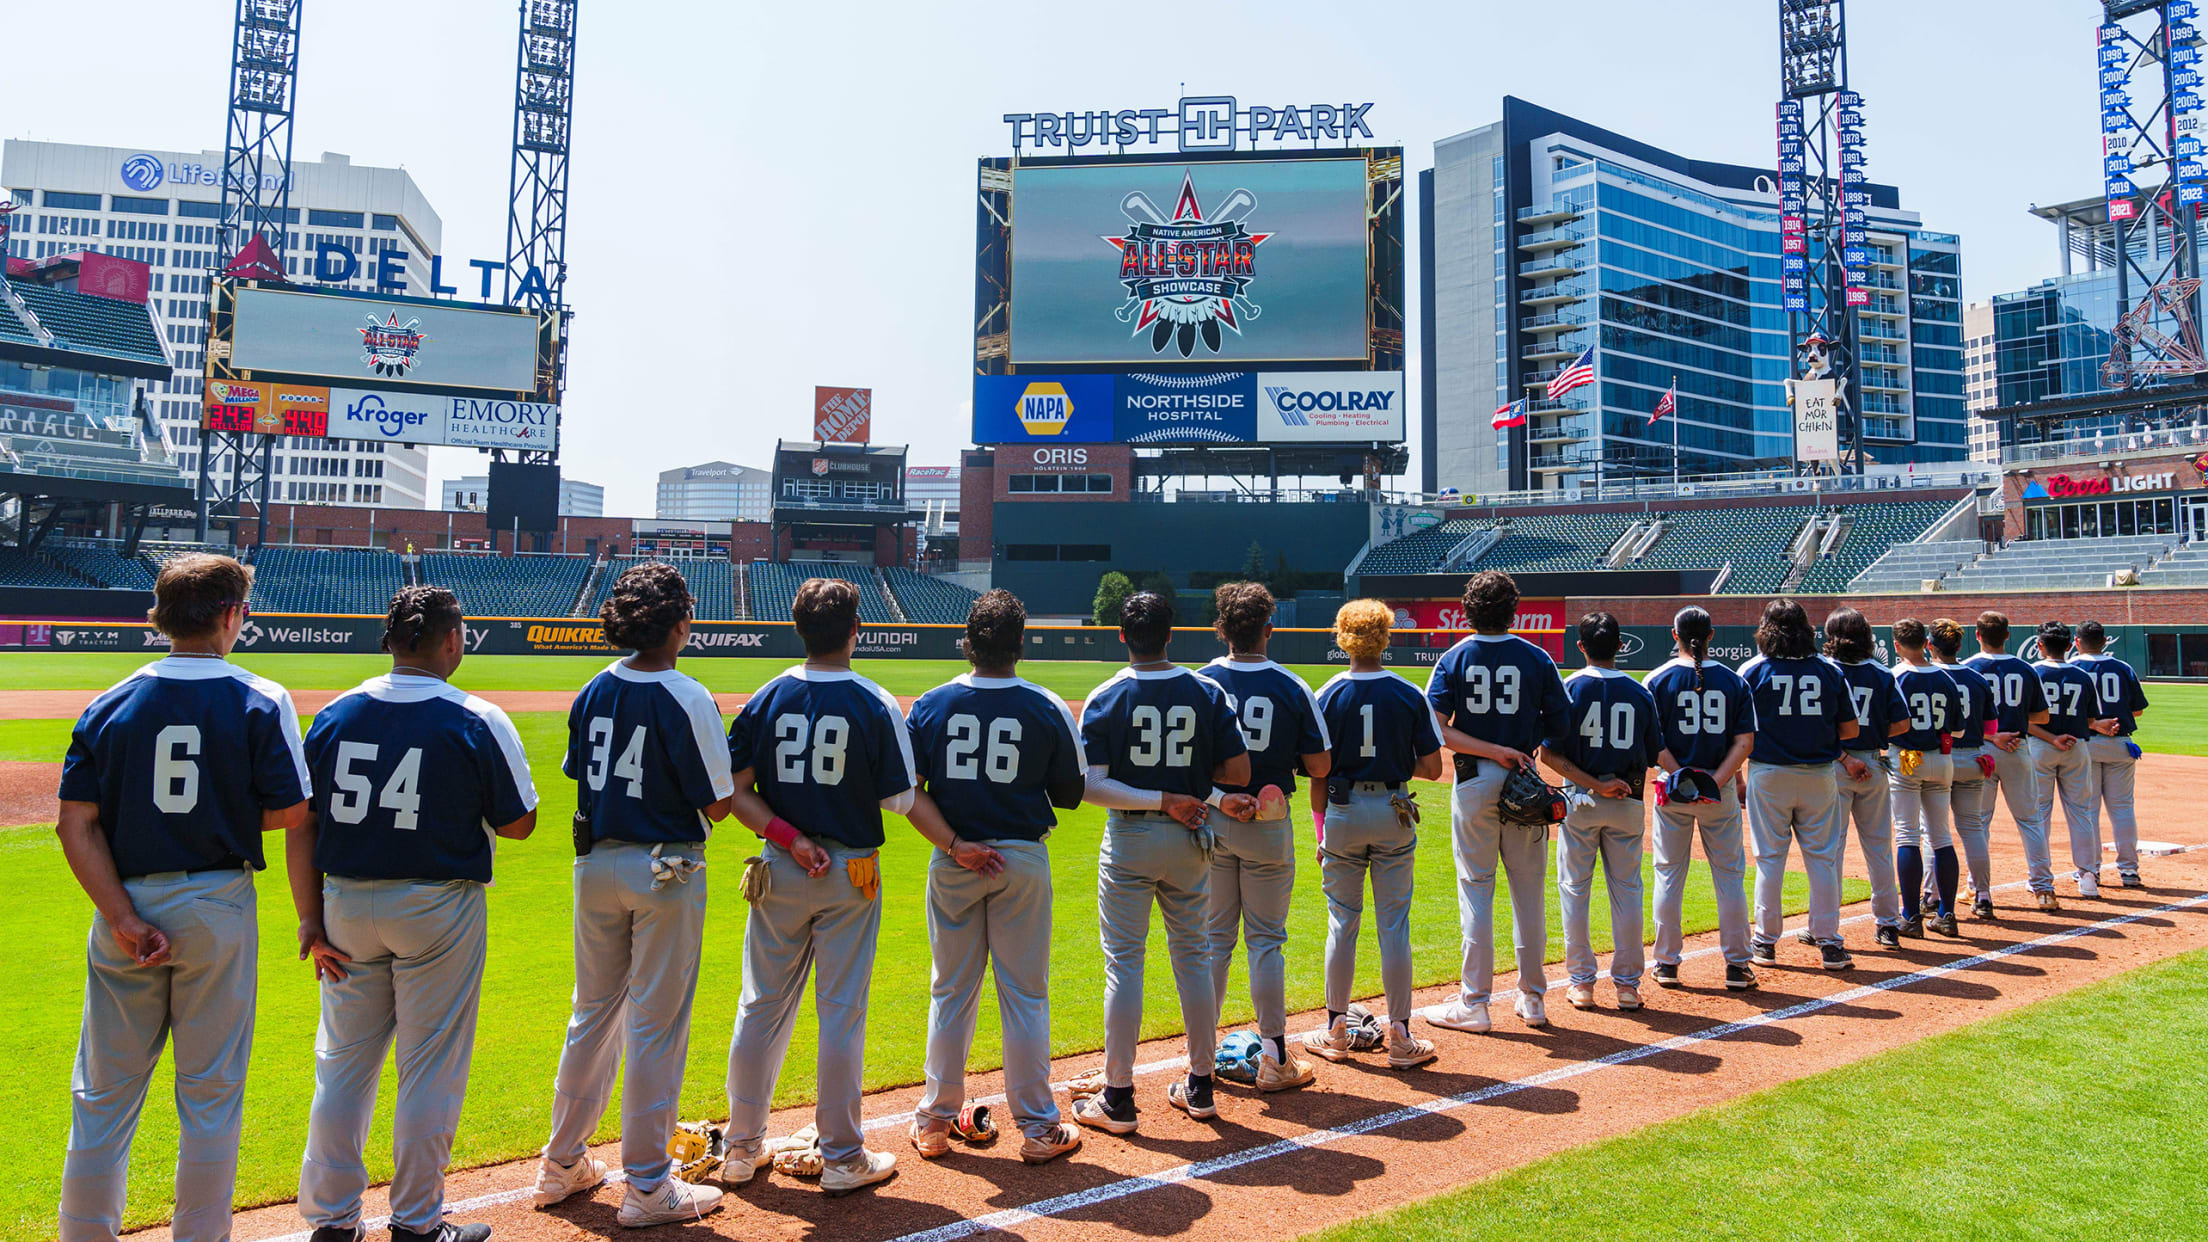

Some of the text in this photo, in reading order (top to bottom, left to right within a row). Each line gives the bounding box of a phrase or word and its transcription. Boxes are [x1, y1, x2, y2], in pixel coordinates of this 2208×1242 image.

[2170, 4, 2190, 18] 1997
[2101, 27, 2121, 40] 1996
[2171, 26, 2193, 41] 1999
[2102, 49, 2122, 62] 1998
[2172, 49, 2194, 63] 2001
[2103, 70, 2124, 84] 2000
[2174, 71, 2197, 86] 2003
[1840, 94, 1858, 104] 1873
[2104, 92, 2126, 105] 2002
[2175, 94, 2198, 109] 2005
[1780, 105, 1797, 114] 1872
[1003, 102, 1375, 147] TRUIST PARK
[1841, 114, 1859, 124] 1875
[2106, 114, 2127, 128] 2004
[2177, 118, 2198, 131] 2012
[1781, 124, 1798, 134] 1874
[1781, 143, 1798, 153] 1877
[2107, 136, 2127, 149] 2010
[2178, 141, 2200, 154] 2018
[1843, 153, 1860, 163] 1891
[2108, 159, 2129, 172] 2013
[2179, 164, 2202, 178] 2020
[1782, 181, 1801, 192] 1892
[2109, 181, 2130, 194] 2019
[2181, 187, 2203, 201] 2022
[1783, 200, 1801, 211] 1897
[2110, 203, 2131, 216] 2021
[1845, 212, 1864, 222] 1948
[1784, 220, 1801, 230] 1914
[1152, 227, 1222, 237] NATIVE AMERICAN
[1846, 232, 1865, 242] 1958
[1784, 240, 1802, 250] 1957
[1119, 240, 1256, 278] ALL-STAR
[1847, 252, 1865, 262] 1982
[1785, 259, 1803, 269] 1969
[316, 242, 552, 305] DELTA
[1847, 271, 1866, 282] 1992
[1153, 281, 1222, 294] SHOWCASE
[1786, 278, 1803, 289] 1991
[1786, 298, 1804, 308] 1993
[228, 385, 260, 397] MEGA
[821, 393, 844, 414] THE
[1127, 395, 1244, 409] NORTHSIDE
[1277, 391, 1395, 412] COOLRAY
[1806, 397, 1825, 408] EAT
[211, 404, 254, 424] 343
[452, 398, 552, 425] EMORY
[815, 389, 871, 441] HOME
[1025, 397, 1065, 420] NAPA
[1805, 409, 1827, 420] MOR
[285, 410, 328, 429] 440
[347, 394, 428, 437] Kroger
[1148, 411, 1223, 421] HOSPITAL
[210, 421, 252, 432] MILLION
[836, 408, 870, 441] DEPOT
[1315, 419, 1350, 427] Plumbing
[1798, 421, 1832, 432] CHIKIN
[285, 427, 326, 437] MILLION
[451, 423, 546, 438] HEALTHCARE
[490, 440, 522, 448] Healthcare
[523, 442, 548, 450] Provider
[1033, 448, 1088, 464] ORIS
[691, 468, 727, 477] Travelport
[829, 462, 870, 472] CLUBHOUSE
[908, 468, 946, 476] RaceTrac
[2047, 472, 2176, 497] Coors LIGHT
[1437, 608, 1553, 630] Sta arm
[78, 631, 118, 639] TYM
[268, 627, 353, 643] Wellstar
[527, 625, 604, 643] QUIKRE
[856, 632, 917, 644] YUNDAI
[1814, 631, 1823, 639] 75
[686, 632, 765, 650] QUIFAX
[1327, 649, 1350, 661] globa
[1414, 652, 1443, 661] TRUIS
[1707, 643, 1752, 661] eorgia
[1465, 665, 1520, 714] 33
[1772, 675, 1822, 716] 72
[1677, 689, 1726, 735] 39
[1227, 693, 1274, 752] 9
[1580, 701, 1635, 750] 40
[1129, 705, 1196, 767] 32
[1359, 704, 1376, 758] 1
[775, 713, 850, 786] 28
[946, 713, 1023, 784] 26
[587, 716, 647, 800] 34
[153, 724, 202, 814] 6
[330, 740, 423, 830] 54
